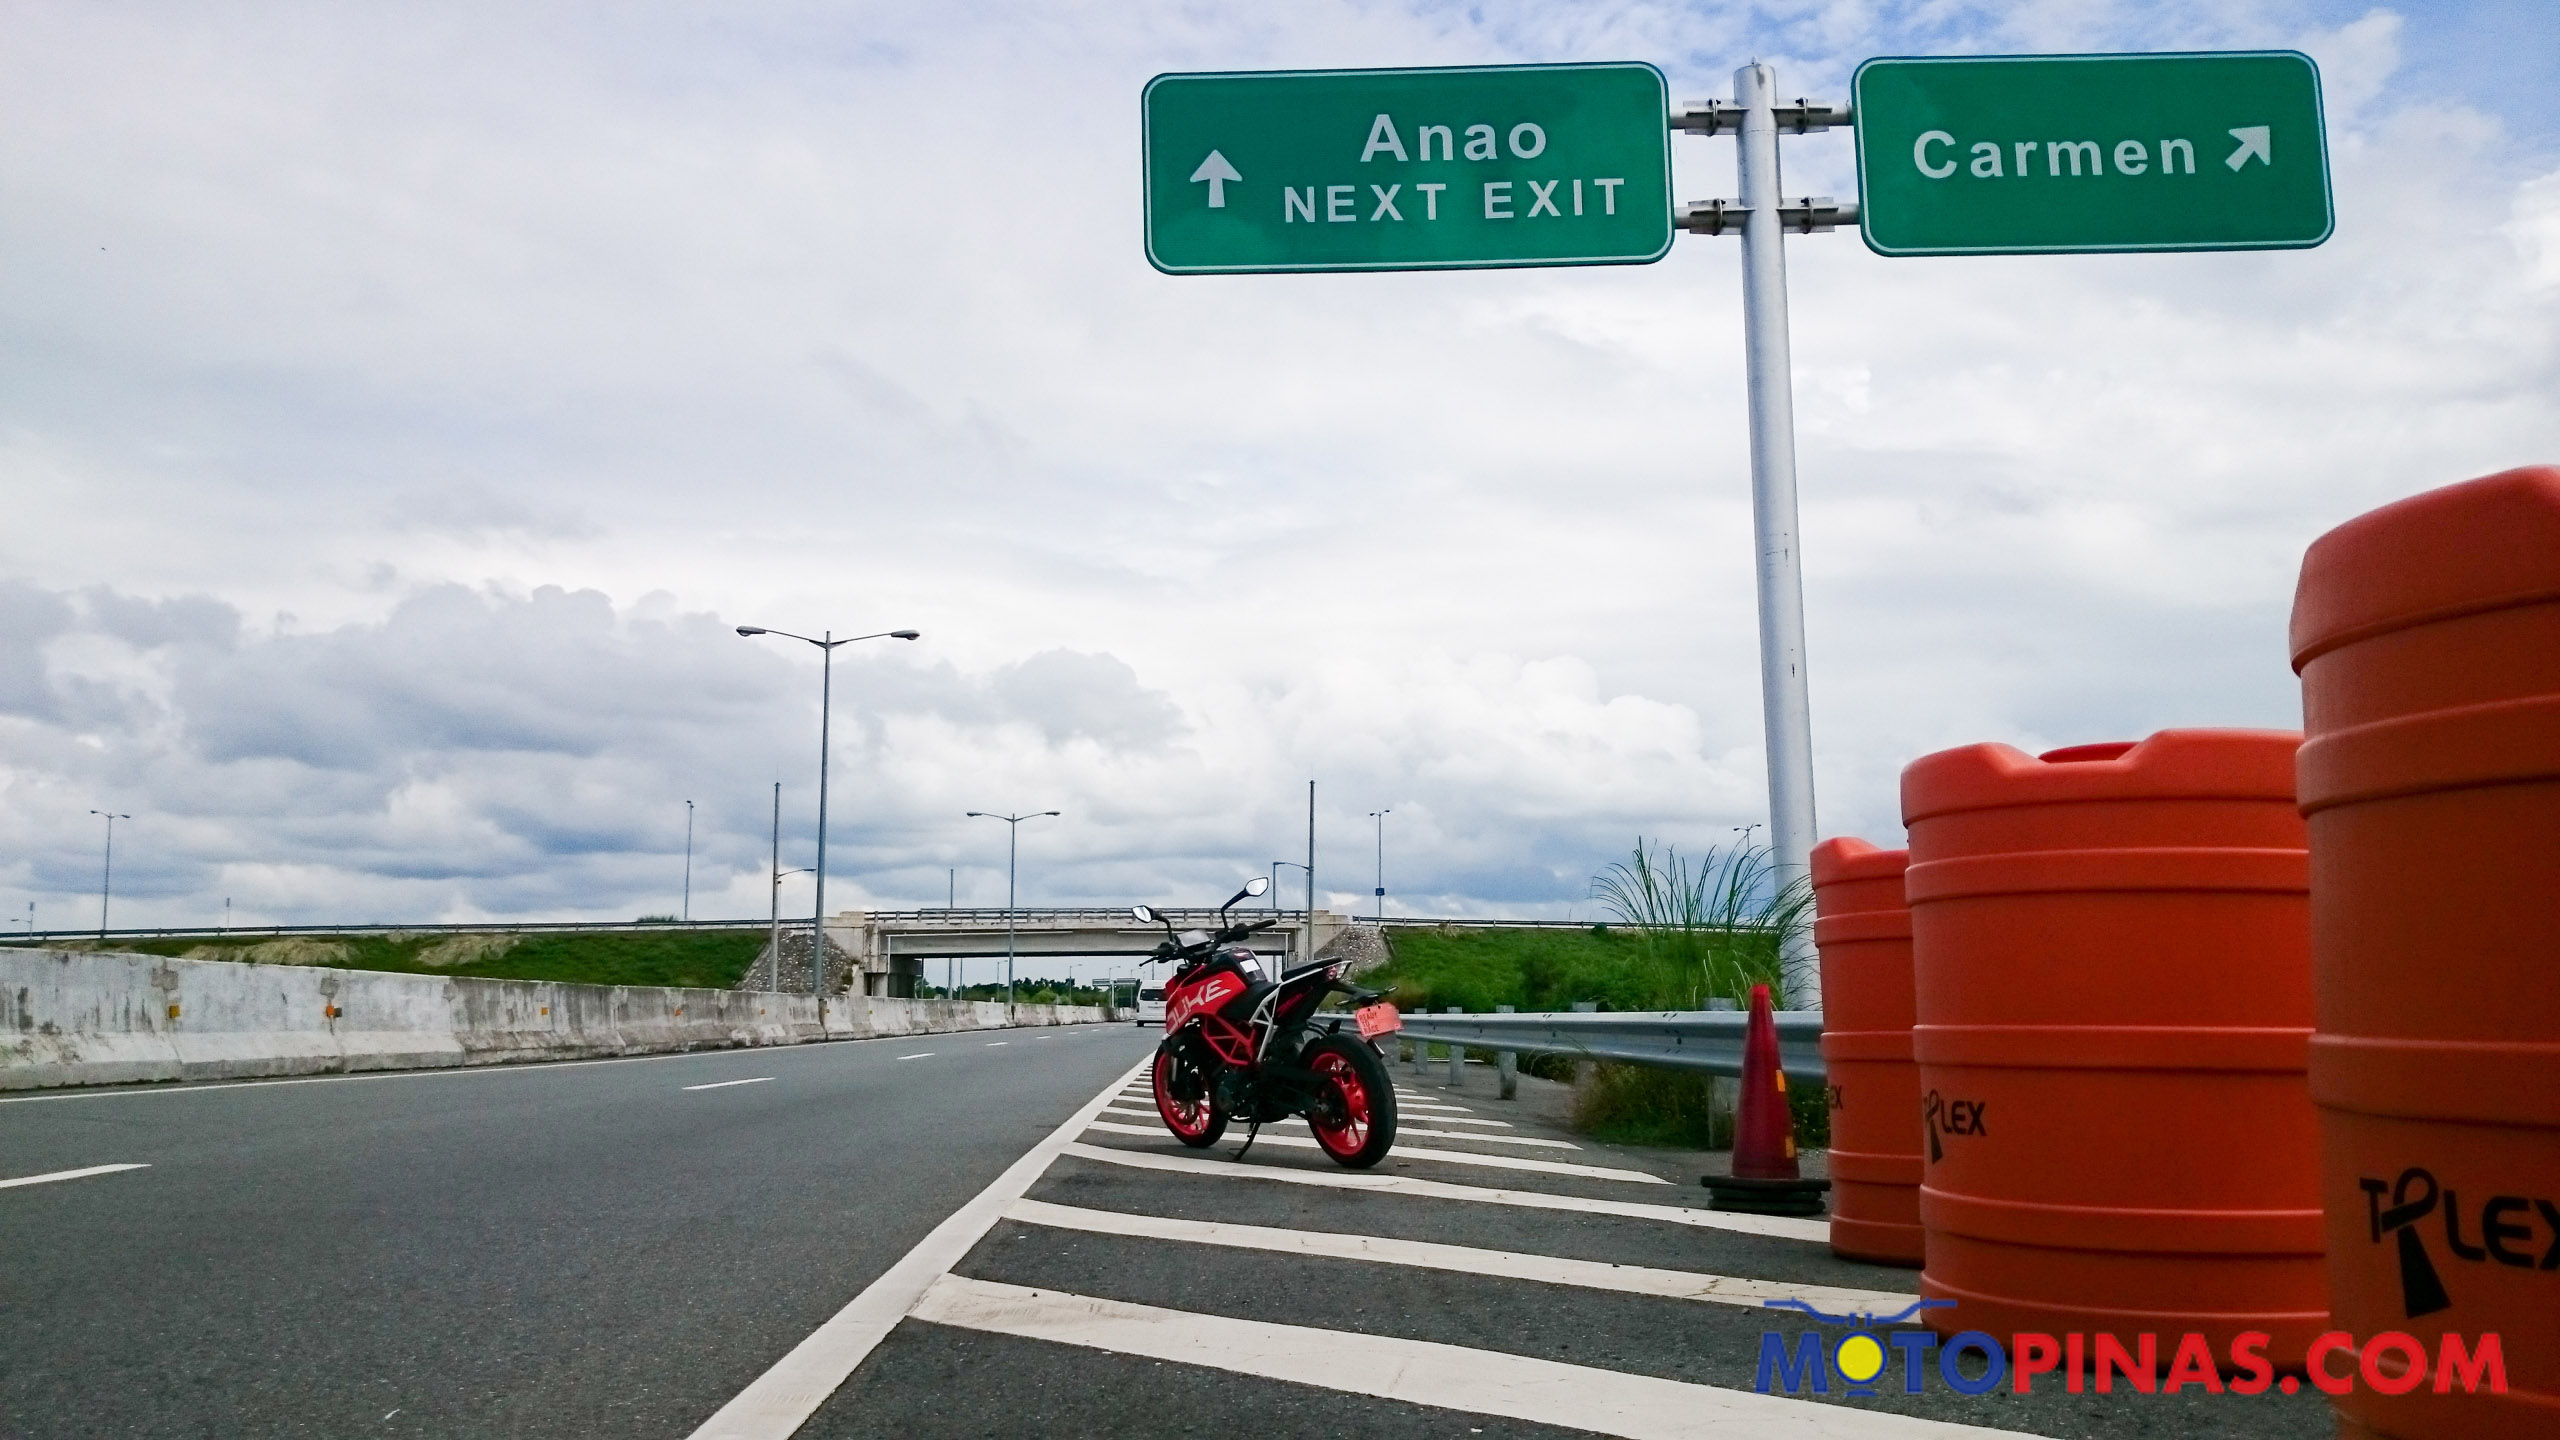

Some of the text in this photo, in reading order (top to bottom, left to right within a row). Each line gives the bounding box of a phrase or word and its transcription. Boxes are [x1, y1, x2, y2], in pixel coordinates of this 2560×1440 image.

[1360, 113, 1546, 163] Anao
[1913, 130, 2196, 179] Carmen
[1284, 178, 1625, 223] NEXT EXIT
[1167, 979, 1232, 1036] DUKE
[1925, 1089, 1988, 1165] PLEX
